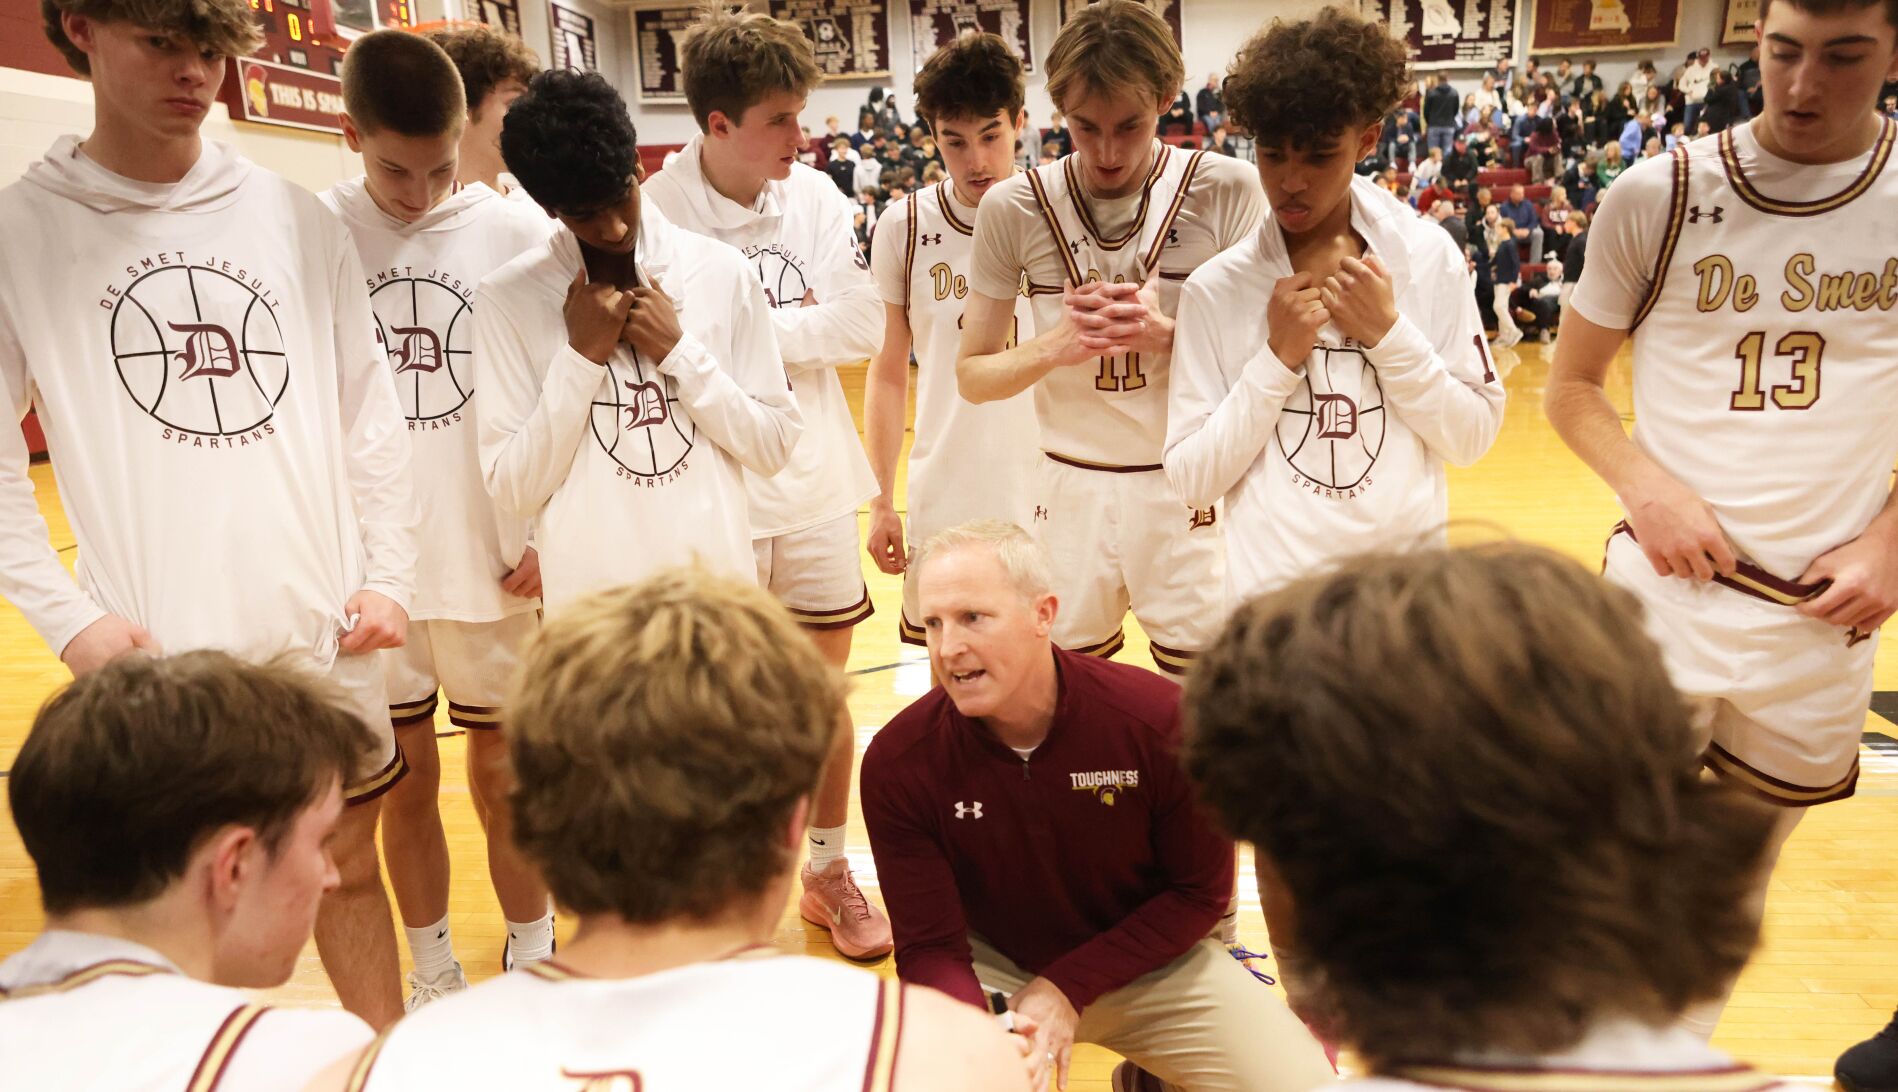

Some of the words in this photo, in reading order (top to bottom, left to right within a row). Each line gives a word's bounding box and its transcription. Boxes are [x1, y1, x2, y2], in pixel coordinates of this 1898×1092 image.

[288, 13, 302, 41] 0
[269, 82, 302, 108] THIS
[302, 88, 317, 111] IS
[317, 91, 348, 115] SPA
[100, 285, 121, 310] DE
[126, 252, 184, 277] SMET
[206, 257, 280, 308] JESUIT
[366, 267, 412, 289] SMET
[428, 269, 474, 300] JESU
[929, 262, 969, 301] De
[1693, 254, 1759, 313] De
[1780, 252, 1898, 312] Smet
[167, 320, 241, 382] D
[390, 325, 443, 374] D
[1095, 351, 1147, 392] 11
[1729, 331, 1826, 411] 13
[408, 412, 461, 431] RTANS
[624, 380, 668, 431] D
[1314, 393, 1357, 440] D
[162, 424, 275, 448] SPARTANS
[616, 461, 689, 488] SPARTANS
[1291, 475, 1373, 500] SPARTANS
[1069, 770, 1138, 787] TOUGHNESS
